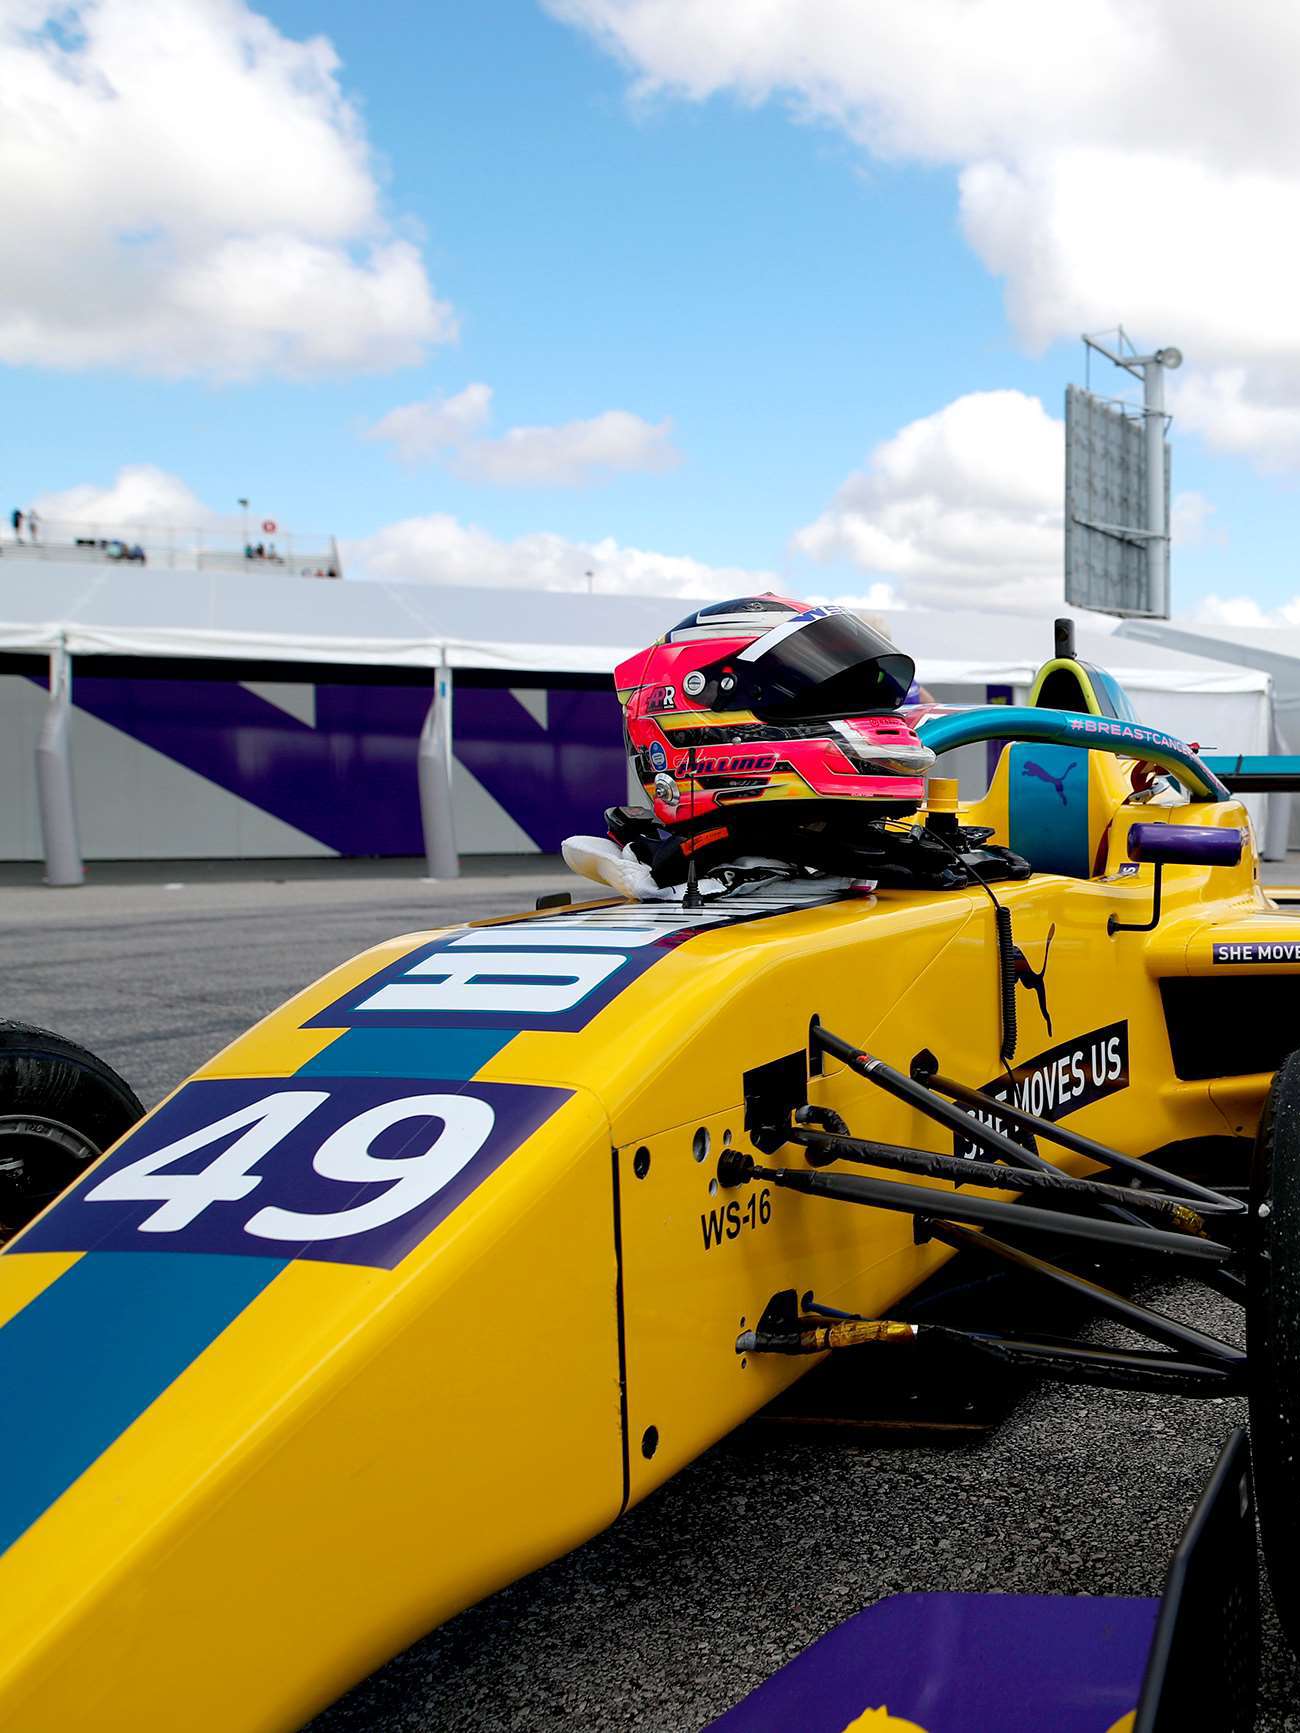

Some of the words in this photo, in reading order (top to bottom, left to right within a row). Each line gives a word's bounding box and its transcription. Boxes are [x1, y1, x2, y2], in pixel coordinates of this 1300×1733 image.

[1219, 946, 1253, 960] SHE
[1013, 1051, 1085, 1120] MOVES
[1091, 1036, 1121, 1087] US
[84, 1091, 497, 1242] 49
[701, 1188, 771, 1251] WS-16
